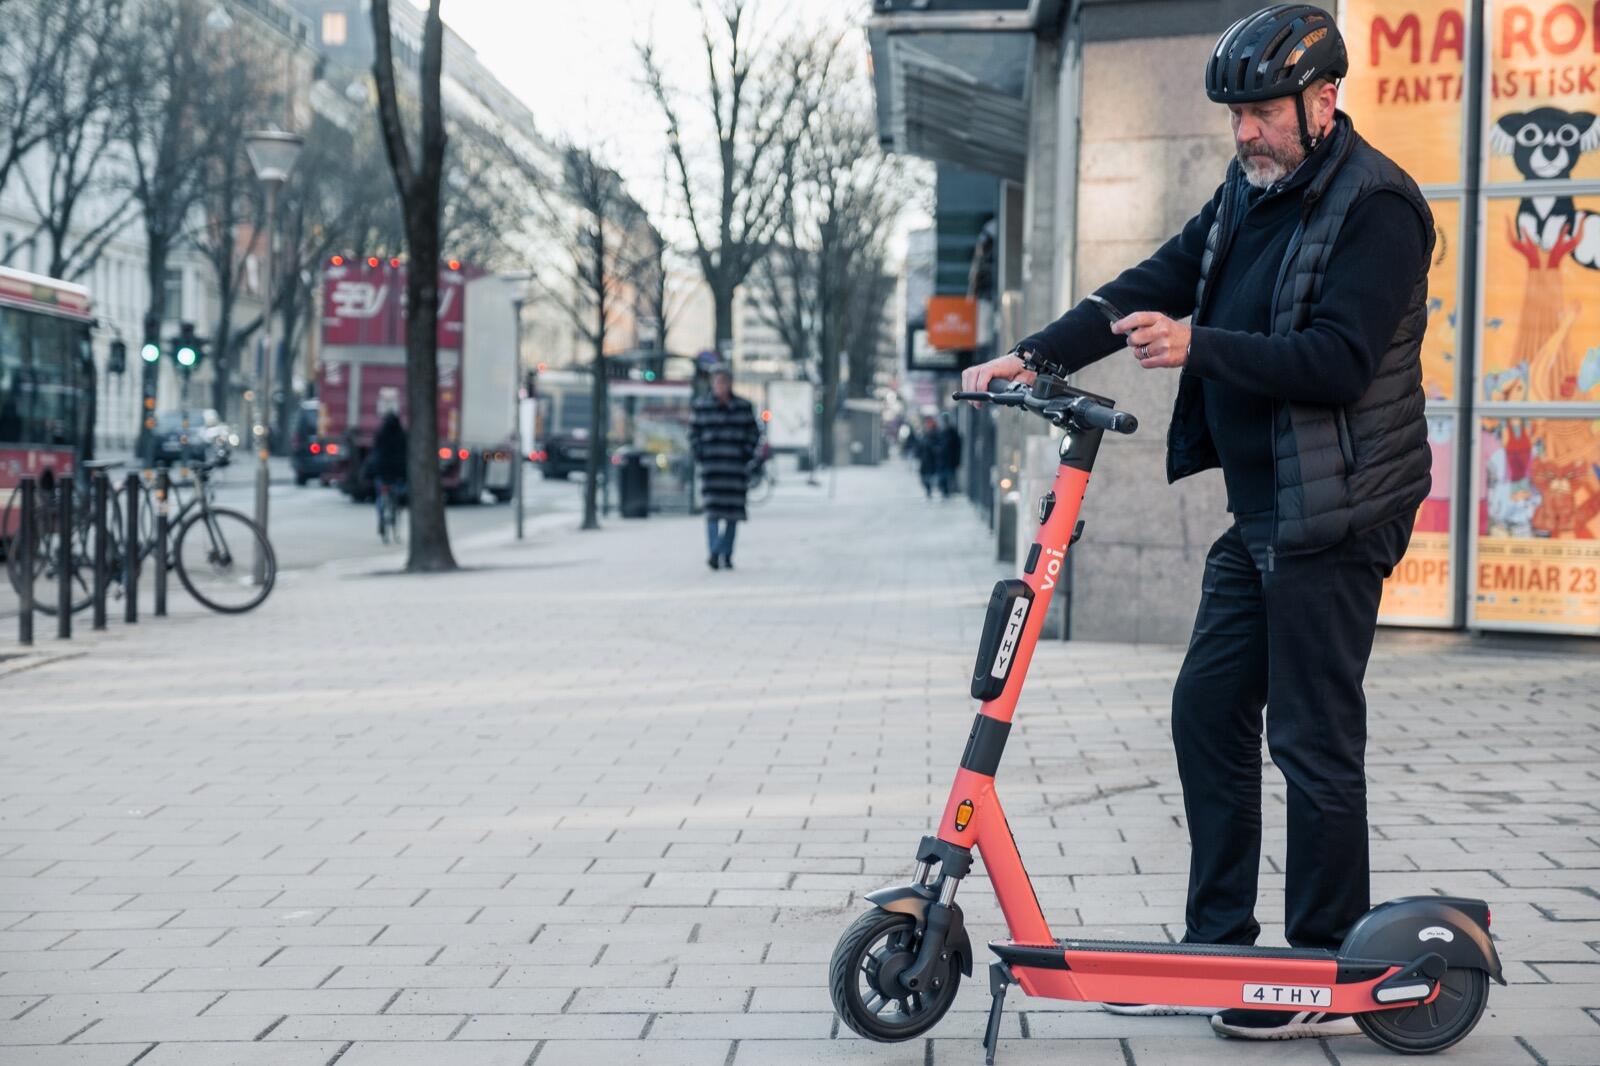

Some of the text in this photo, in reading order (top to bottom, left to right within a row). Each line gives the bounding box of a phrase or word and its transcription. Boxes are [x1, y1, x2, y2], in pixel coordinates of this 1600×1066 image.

[1370, 2, 1600, 67] MARO
[1569, 566, 1598, 594] 23
[999, 606, 1024, 669] 4THY
[1253, 986, 1321, 1004] 4THY
